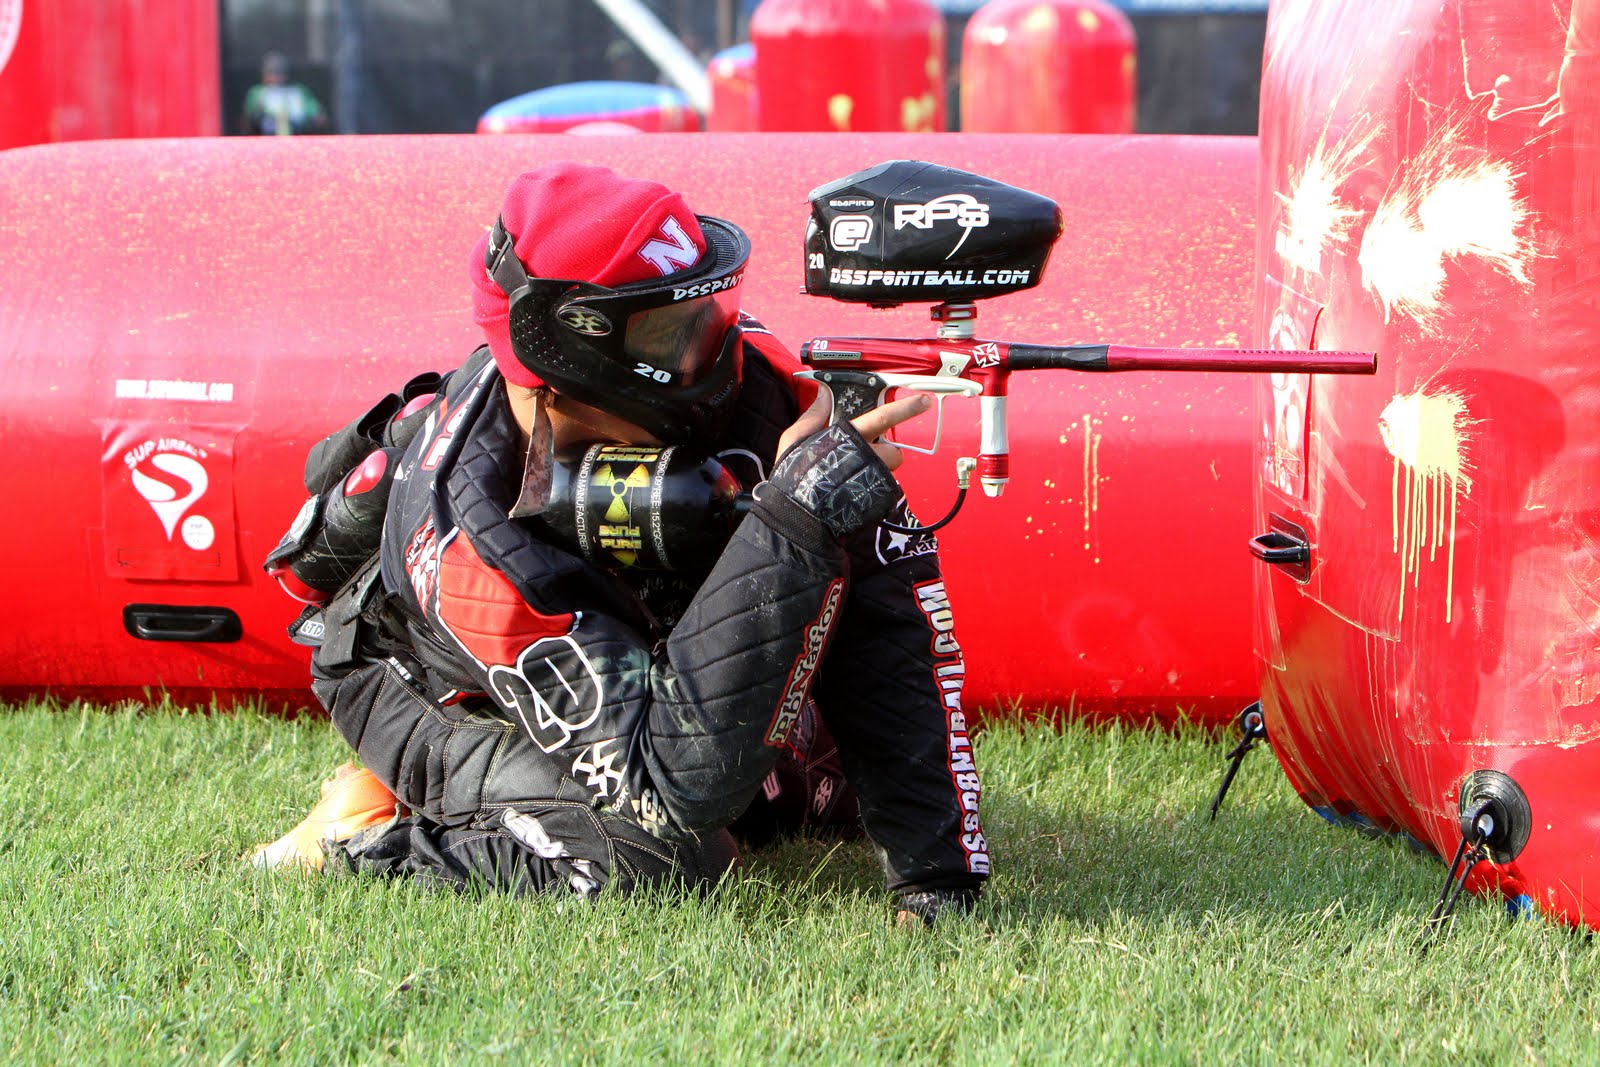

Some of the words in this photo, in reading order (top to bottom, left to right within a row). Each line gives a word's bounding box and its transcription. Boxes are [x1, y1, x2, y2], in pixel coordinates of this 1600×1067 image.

[894, 194, 990, 236] RPS
[637, 215, 700, 276] N
[809, 253, 824, 269] 20
[812, 340, 828, 350] 20
[633, 362, 672, 383] 20
[124, 440, 157, 469] SUP
[579, 462, 591, 479] AND
[576, 479, 589, 550] MANUFACTURED
